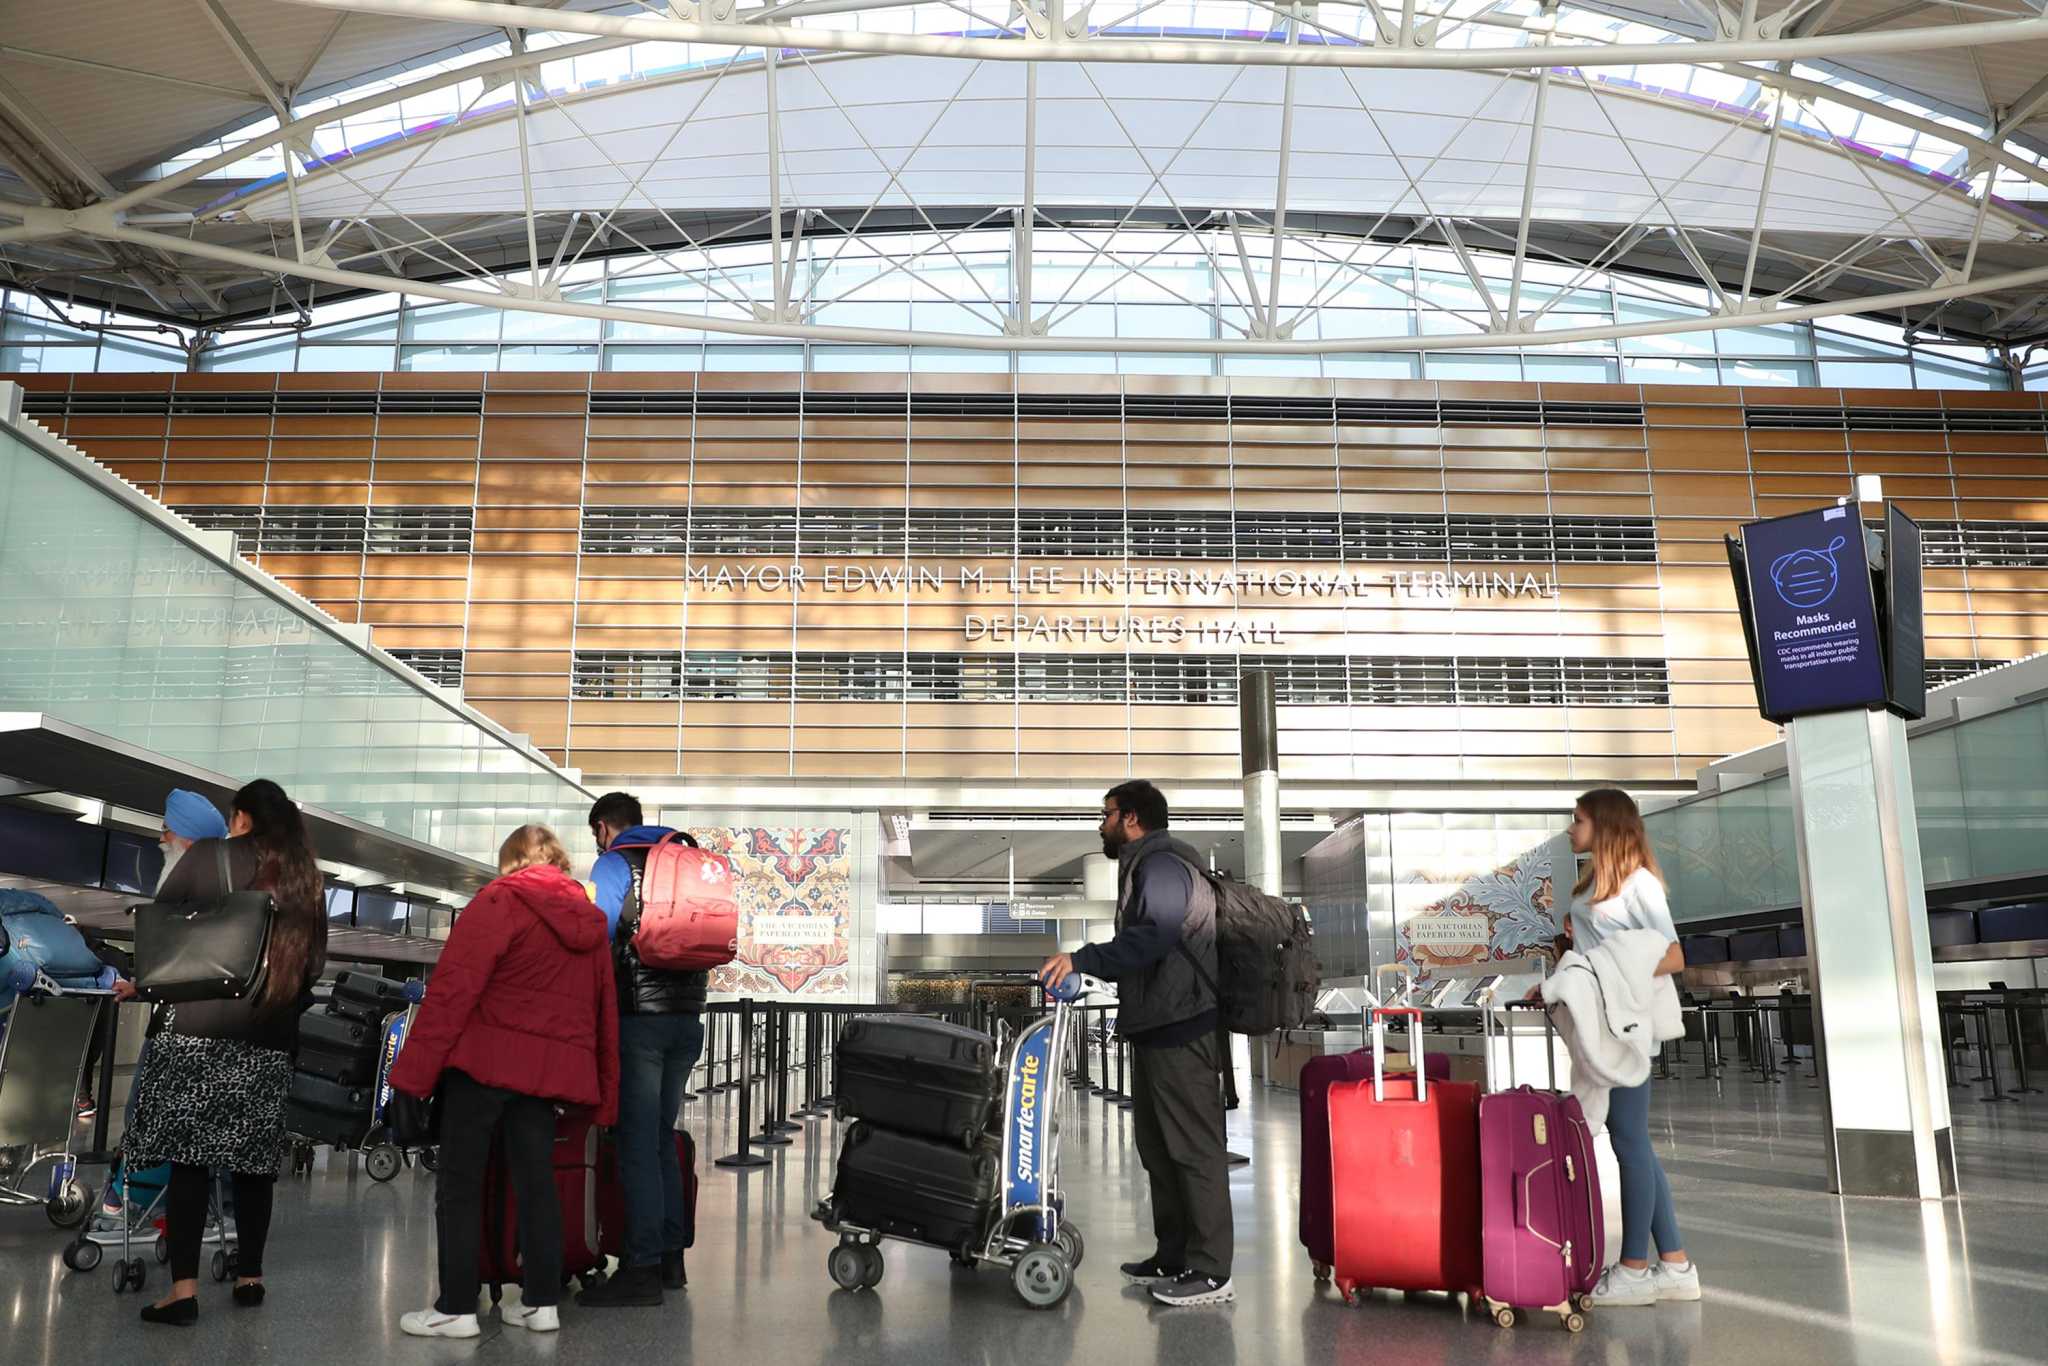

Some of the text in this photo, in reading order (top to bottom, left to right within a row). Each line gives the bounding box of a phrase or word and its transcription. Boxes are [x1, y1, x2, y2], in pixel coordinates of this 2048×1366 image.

[685, 565, 1560, 597] MAYOR EDWIN M. LEE INTERNATIONAL TERMINAL
[1796, 612, 1830, 626] Masks
[964, 614, 1286, 645] DEPARTURES HALL
[1774, 618, 1857, 641] Recommended
[1777, 638, 1859, 656] CDC recommends wearing
[1780, 653, 1800, 663] masks
[1816, 648, 1837, 658] indoor
[1838, 645, 1859, 656] public
[1784, 654, 1857, 670] transportation settings.
[1016, 1054, 1040, 1184] smartecarte
